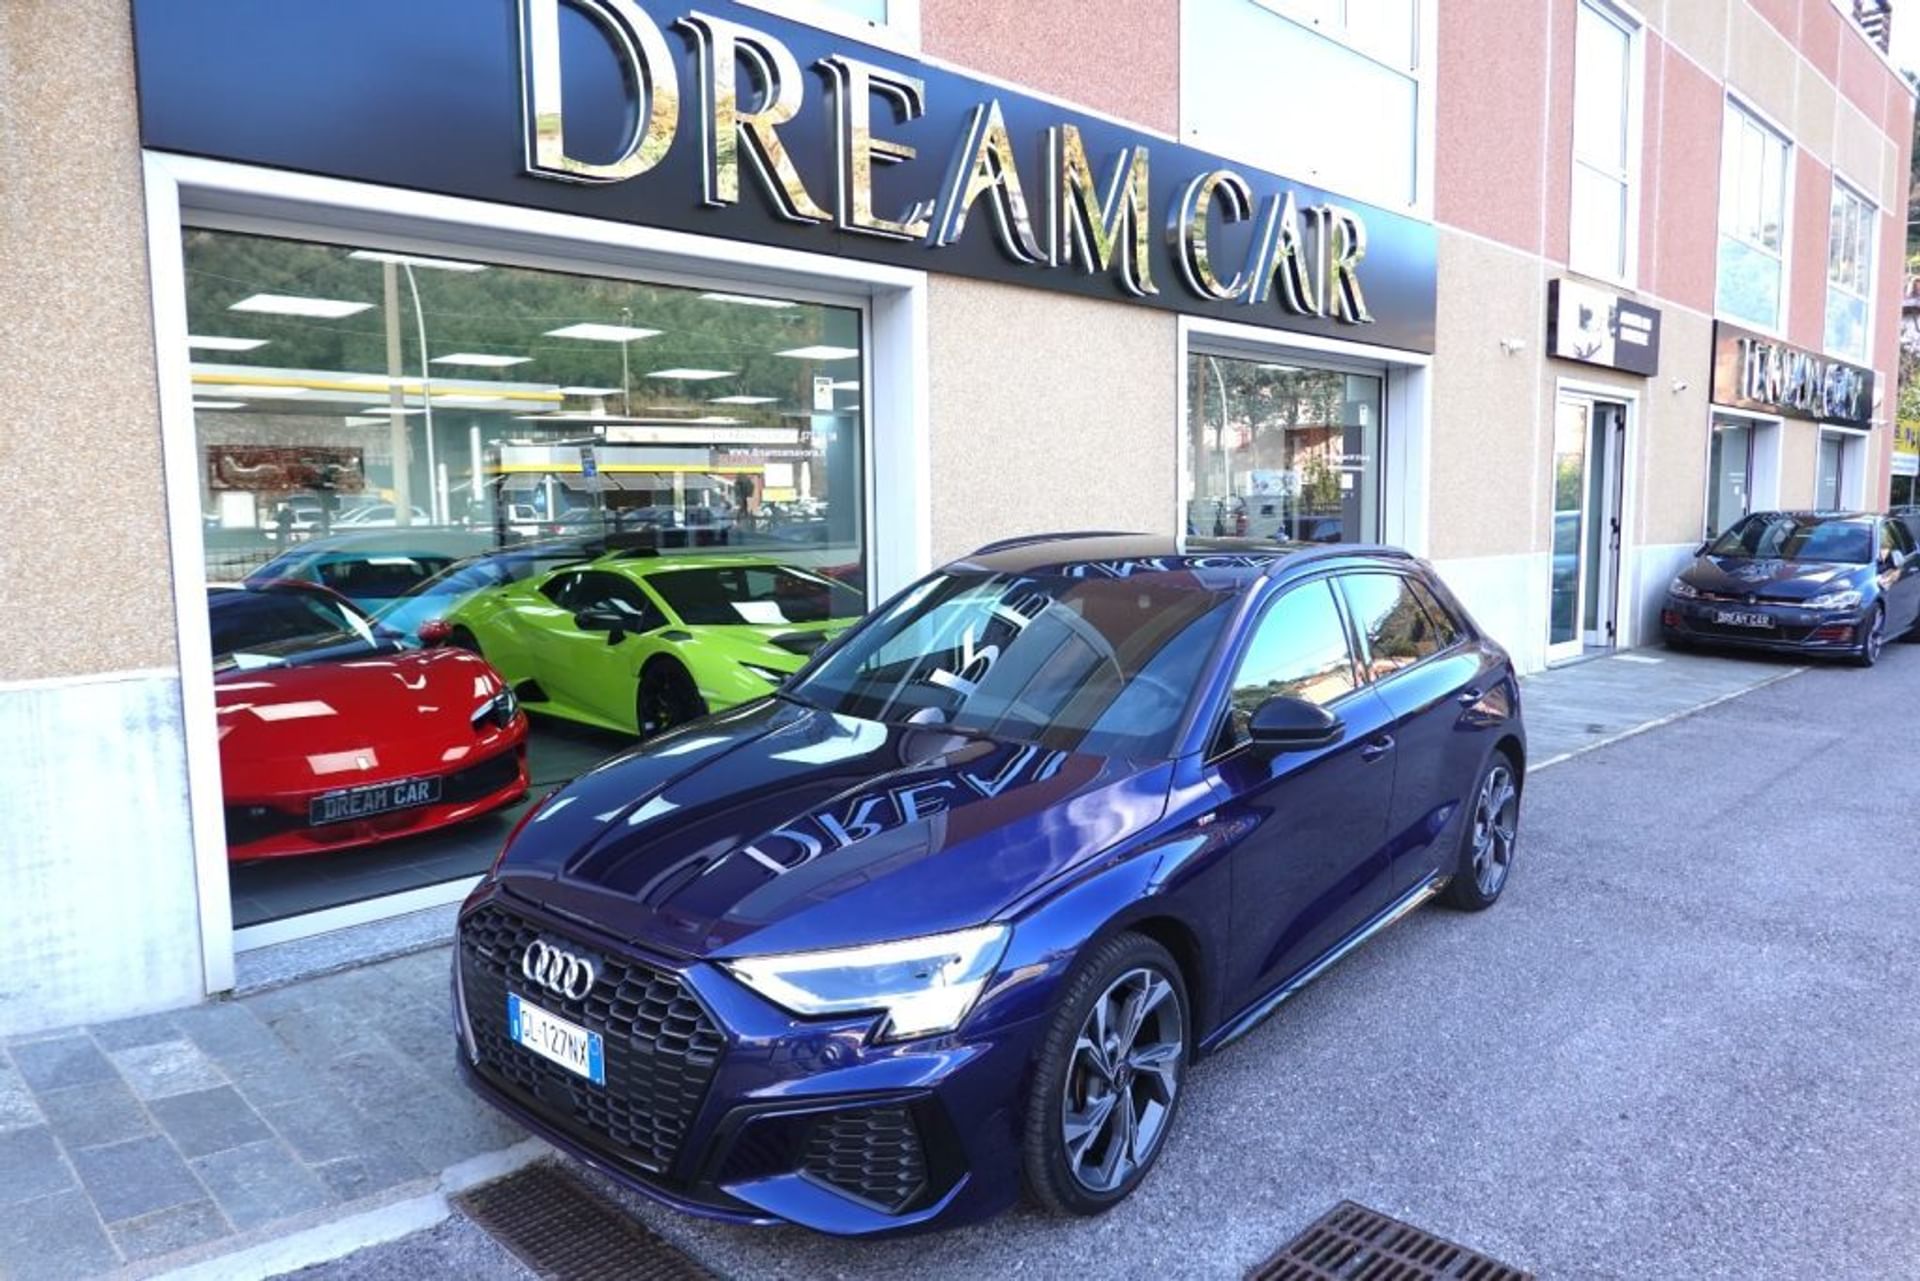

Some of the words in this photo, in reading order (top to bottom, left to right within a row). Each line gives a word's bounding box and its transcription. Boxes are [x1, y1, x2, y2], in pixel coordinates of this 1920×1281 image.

[517, 0, 1159, 297] DREAM
[1168, 169, 1375, 324] CAR
[323, 789, 387, 819] DREAM
[394, 781, 430, 805] CAR
